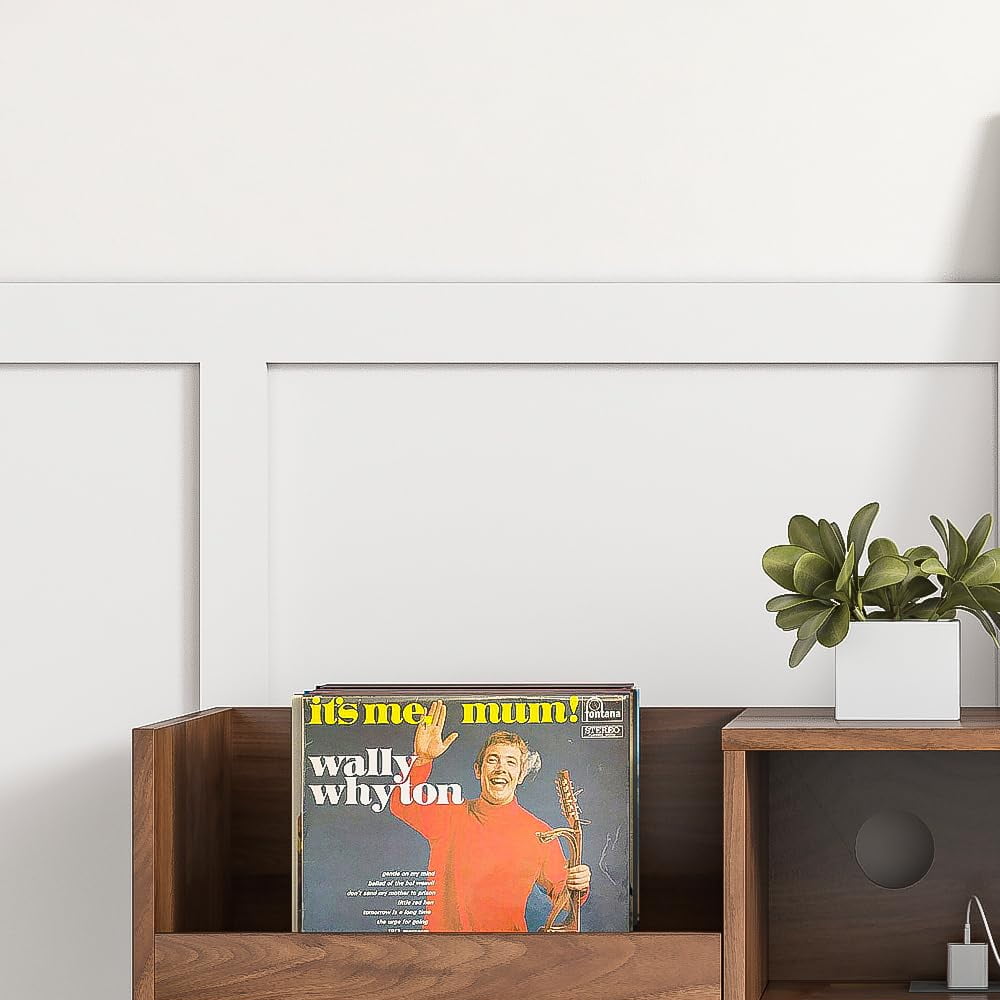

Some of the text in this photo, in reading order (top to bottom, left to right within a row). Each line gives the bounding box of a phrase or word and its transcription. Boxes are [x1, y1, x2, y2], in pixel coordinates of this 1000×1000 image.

[309, 697, 358, 724] it's
[462, 696, 579, 724] mum!
[586, 702, 621, 722] fontana
[308, 748, 419, 784] wally
[308, 777, 465, 812] whyton
